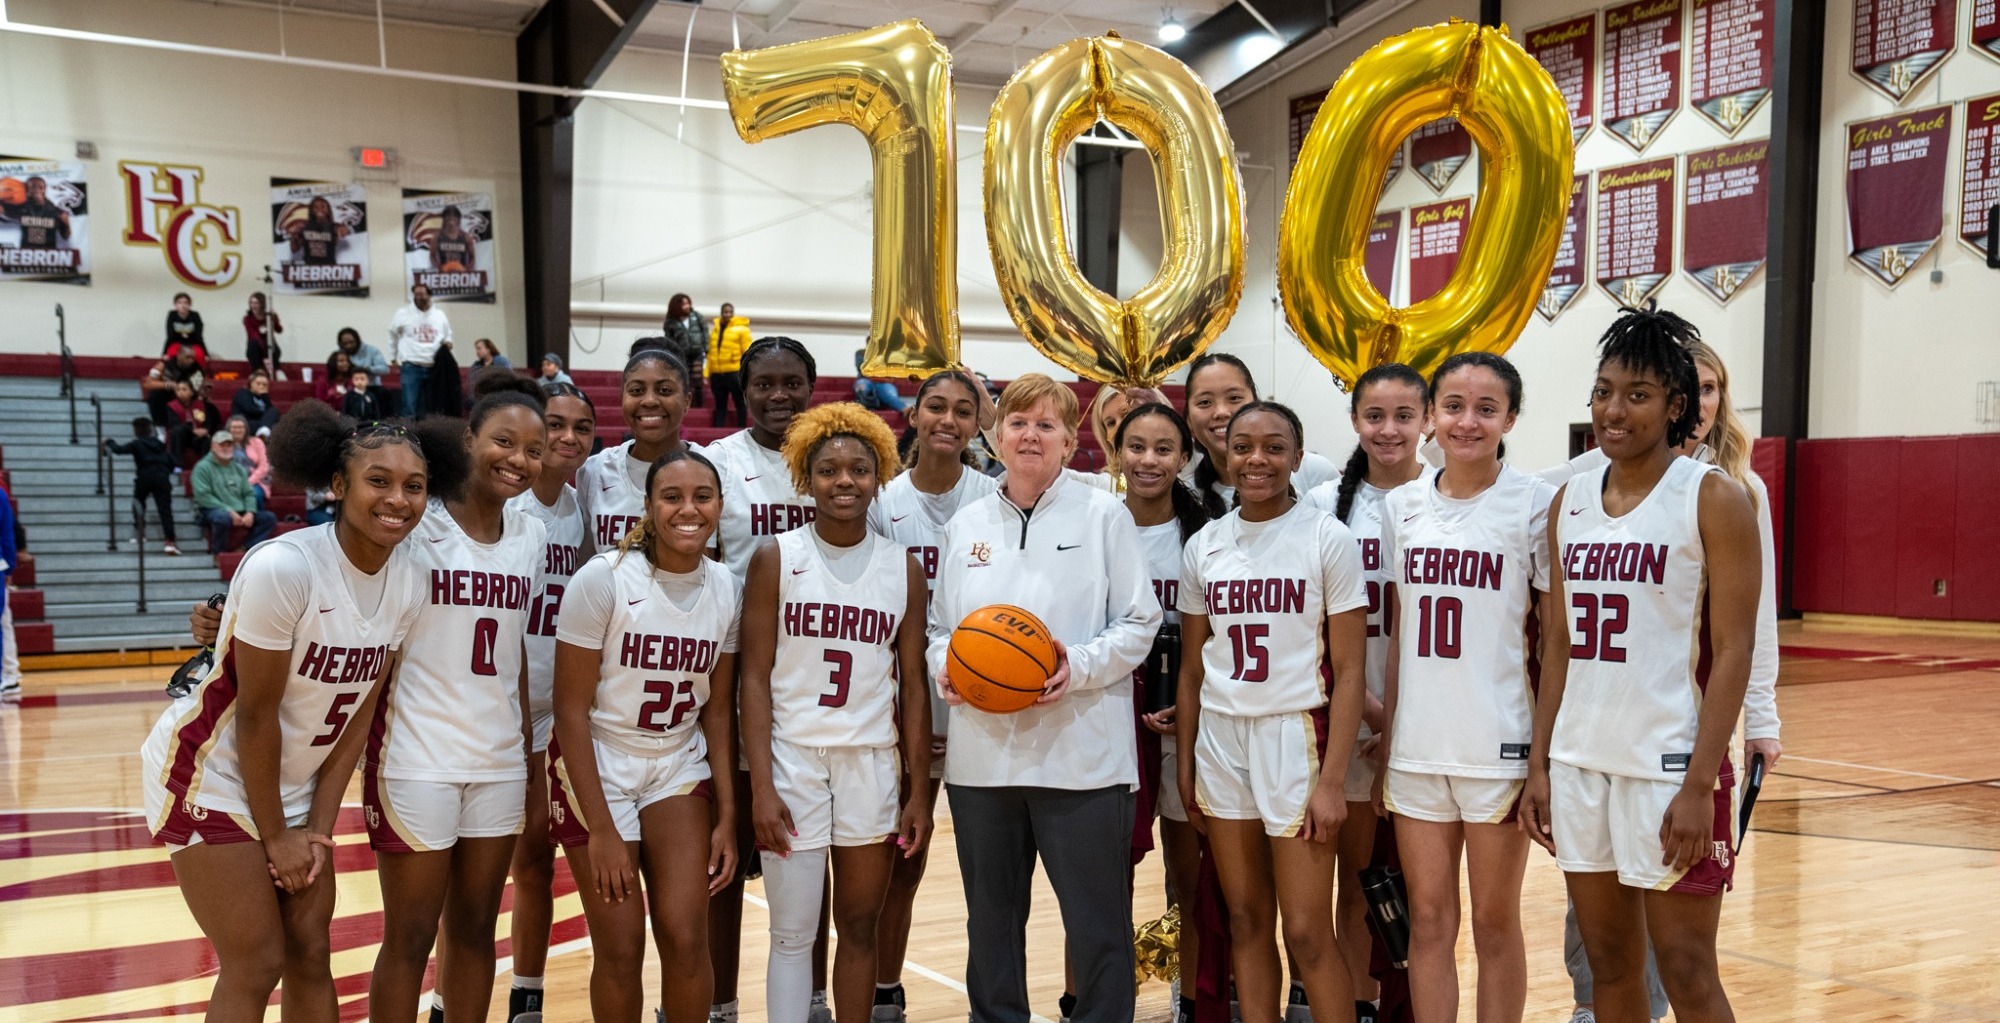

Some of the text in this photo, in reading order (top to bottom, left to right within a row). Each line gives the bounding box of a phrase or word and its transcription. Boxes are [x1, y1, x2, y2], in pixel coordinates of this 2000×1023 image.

[1608, 14, 1628, 27] Boys
[1877, 8, 1931, 30] AREA CHAMPIONS
[1878, 8, 1900, 20] STATE
[1532, 22, 1589, 47] Volleyball
[1876, 28, 1934, 51] STATE CHAMPIONS
[1877, 18, 1932, 40] AREA CHAMPIONS
[1875, 50, 1896, 62] STATE
[1853, 112, 1944, 148] Girls Track
[1870, 154, 1890, 166] STATE
[1892, 147, 1928, 162] QUALIFIER
[1871, 144, 1888, 156] AREA
[1891, 136, 1930, 152] CHAMPIONS
[1691, 147, 1767, 175] Girls Basketball
[1600, 167, 1672, 191] Cheerleading
[1721, 185, 1753, 199] CHAMPIONS
[1726, 175, 1760, 189] CHAMPIONS
[118, 159, 242, 290] HC
[1416, 204, 1466, 227] Girls Golf
[0, 248, 74, 267] HEBRON
[288, 266, 355, 283] HEBRON
[420, 273, 480, 288] HEBRON
[596, 514, 642, 546] HEB
[750, 503, 817, 536] HEBR
[1404, 547, 1504, 590] HEBRON
[1563, 542, 1669, 585] HEBRON
[431, 568, 531, 612] HEBRON
[1204, 578, 1306, 616] HEBRON
[526, 584, 565, 636] 12
[784, 602, 896, 646] HEBRON
[992, 613, 1036, 637] EVO
[1418, 595, 1462, 660] 10
[1570, 592, 1630, 664] 32
[471, 617, 498, 676] 0
[1227, 624, 1270, 682] 15
[298, 641, 390, 684] HEBRO
[1161, 653, 1168, 674] 1
[818, 648, 853, 708] 3
[310, 692, 360, 747] 5
[636, 680, 696, 732] 22
